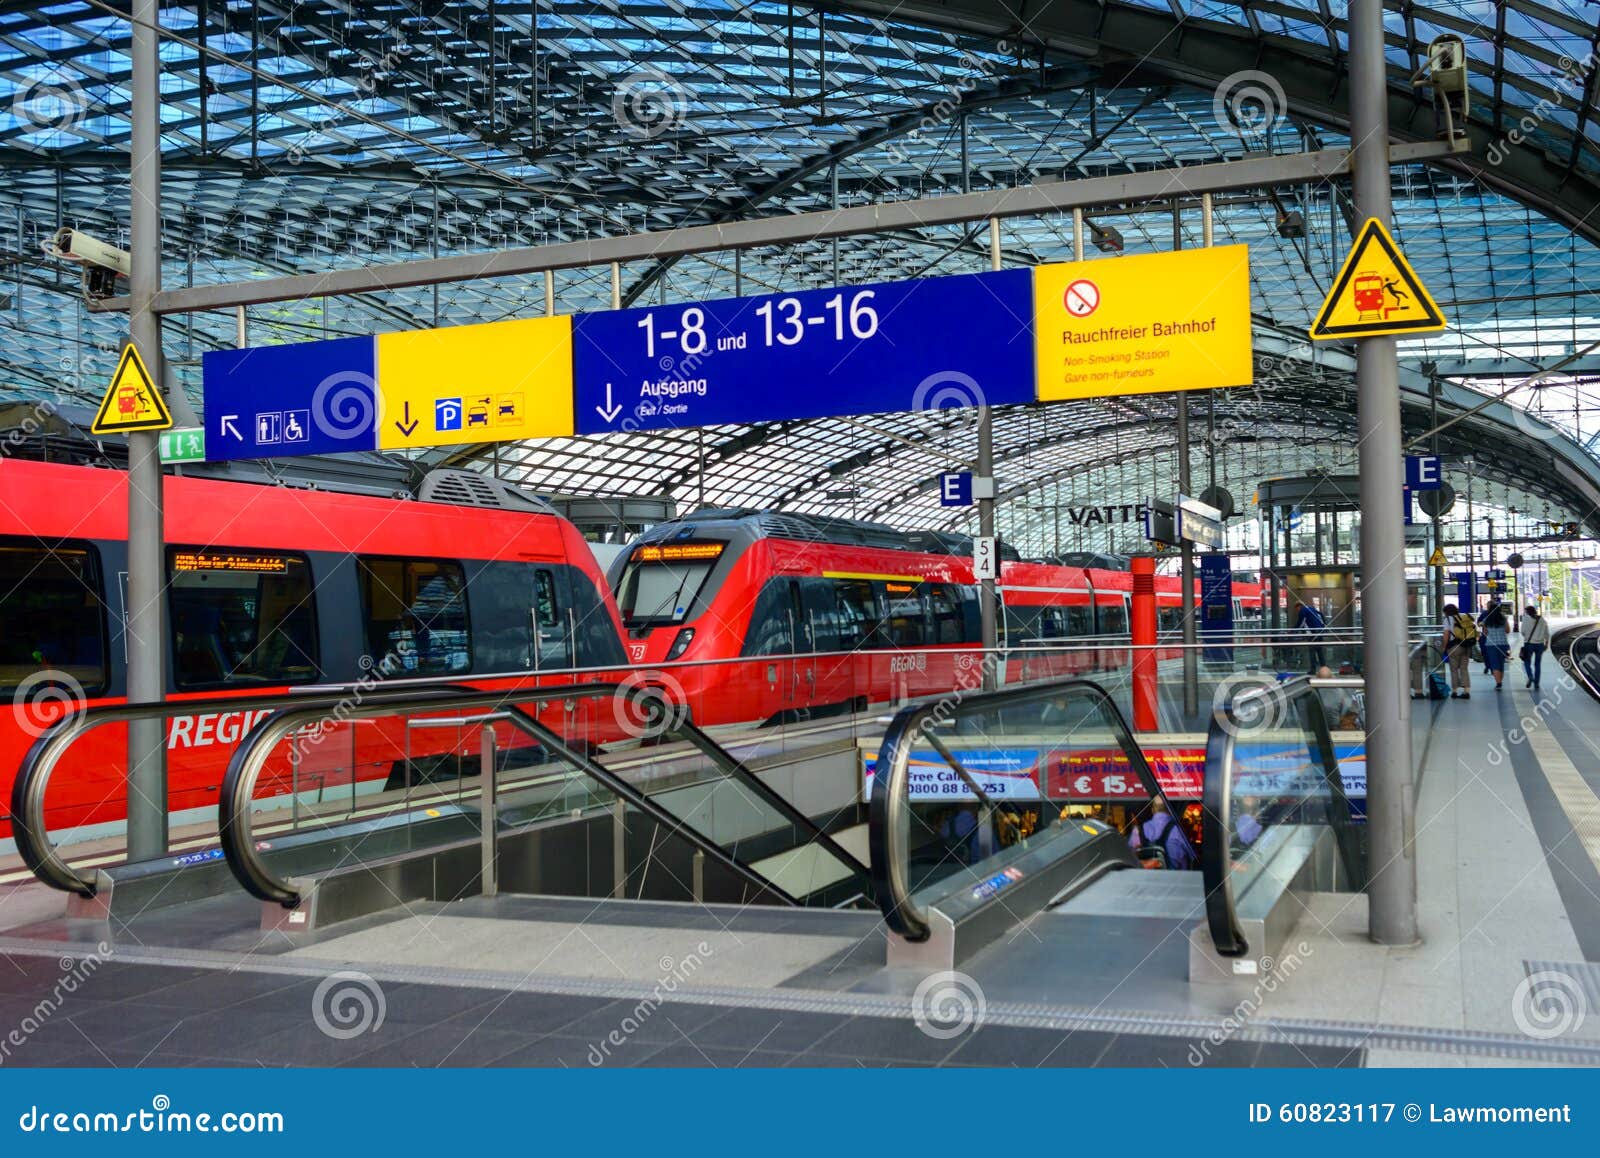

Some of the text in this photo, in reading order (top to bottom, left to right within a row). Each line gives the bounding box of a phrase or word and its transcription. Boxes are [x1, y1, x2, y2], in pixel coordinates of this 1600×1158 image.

[637, 290, 879, 358] 1-8 und 13-16
[1062, 318, 1217, 345] Rauchfreier Bahnhof
[1064, 349, 1170, 367] Non-Smoking Station
[1064, 367, 1155, 384] Gare non-fumeurs
[640, 378, 707, 398] Ausgang
[640, 406, 656, 416] Exit
[663, 403, 688, 415] Sortie
[1419, 456, 1437, 483] E
[944, 474, 960, 500] E
[980, 541, 989, 555] 5
[980, 558, 989, 573] 4
[167, 708, 276, 750] REGI
[1074, 775, 1092, 794] €
